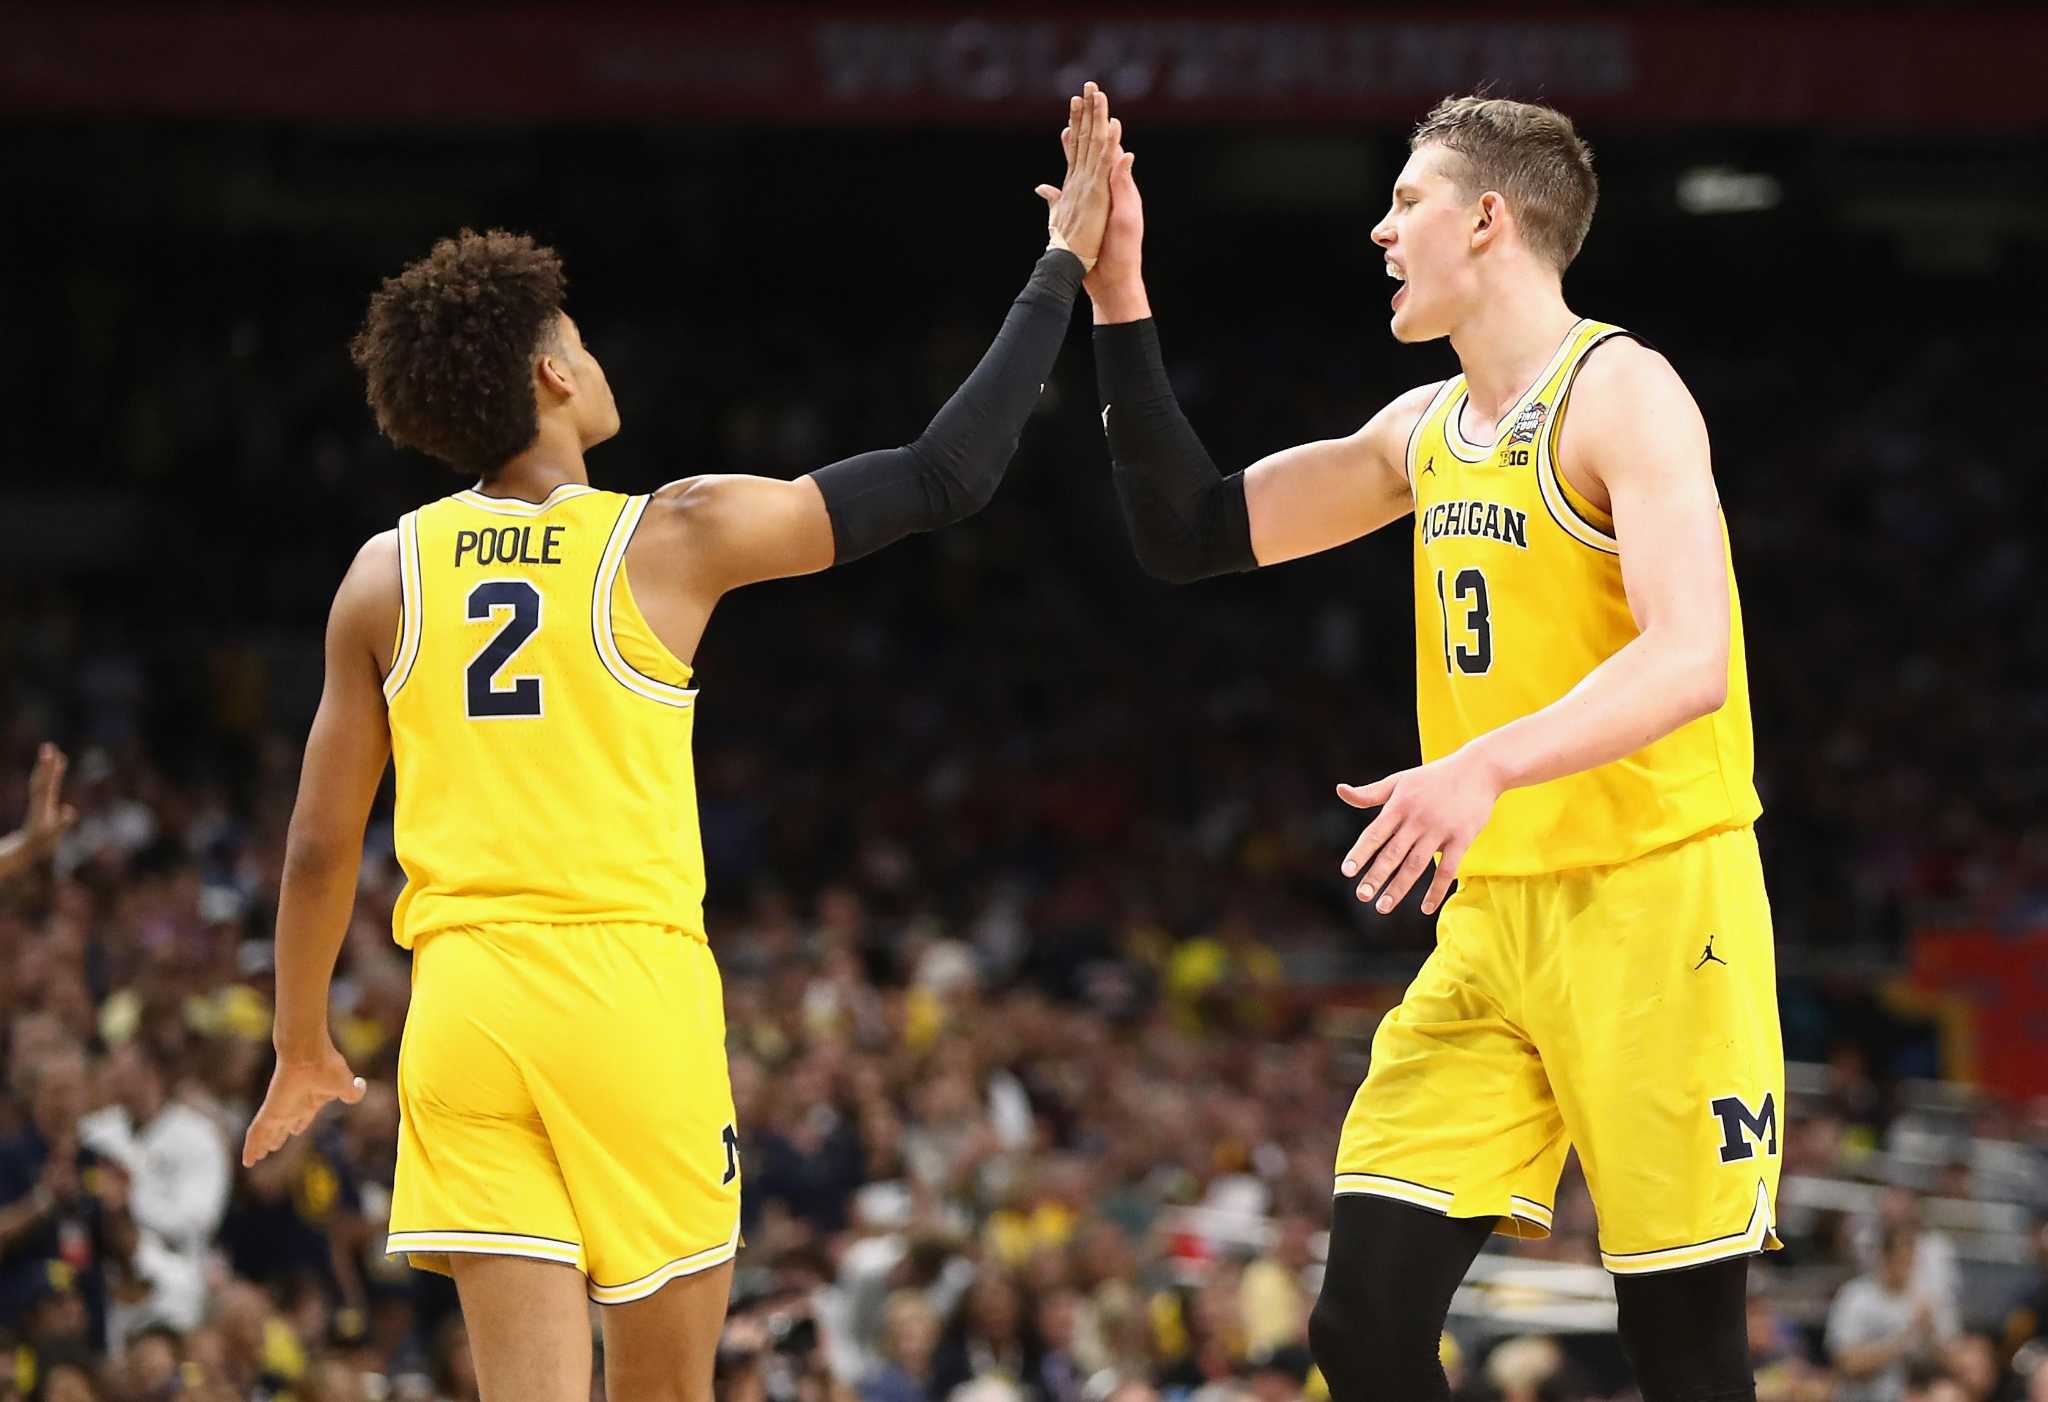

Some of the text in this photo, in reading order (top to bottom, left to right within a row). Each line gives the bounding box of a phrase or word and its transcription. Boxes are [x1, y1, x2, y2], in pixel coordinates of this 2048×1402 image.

[454, 526, 566, 568] POOLE
[464, 579, 543, 718] 2
[1710, 1090, 1777, 1164] M
